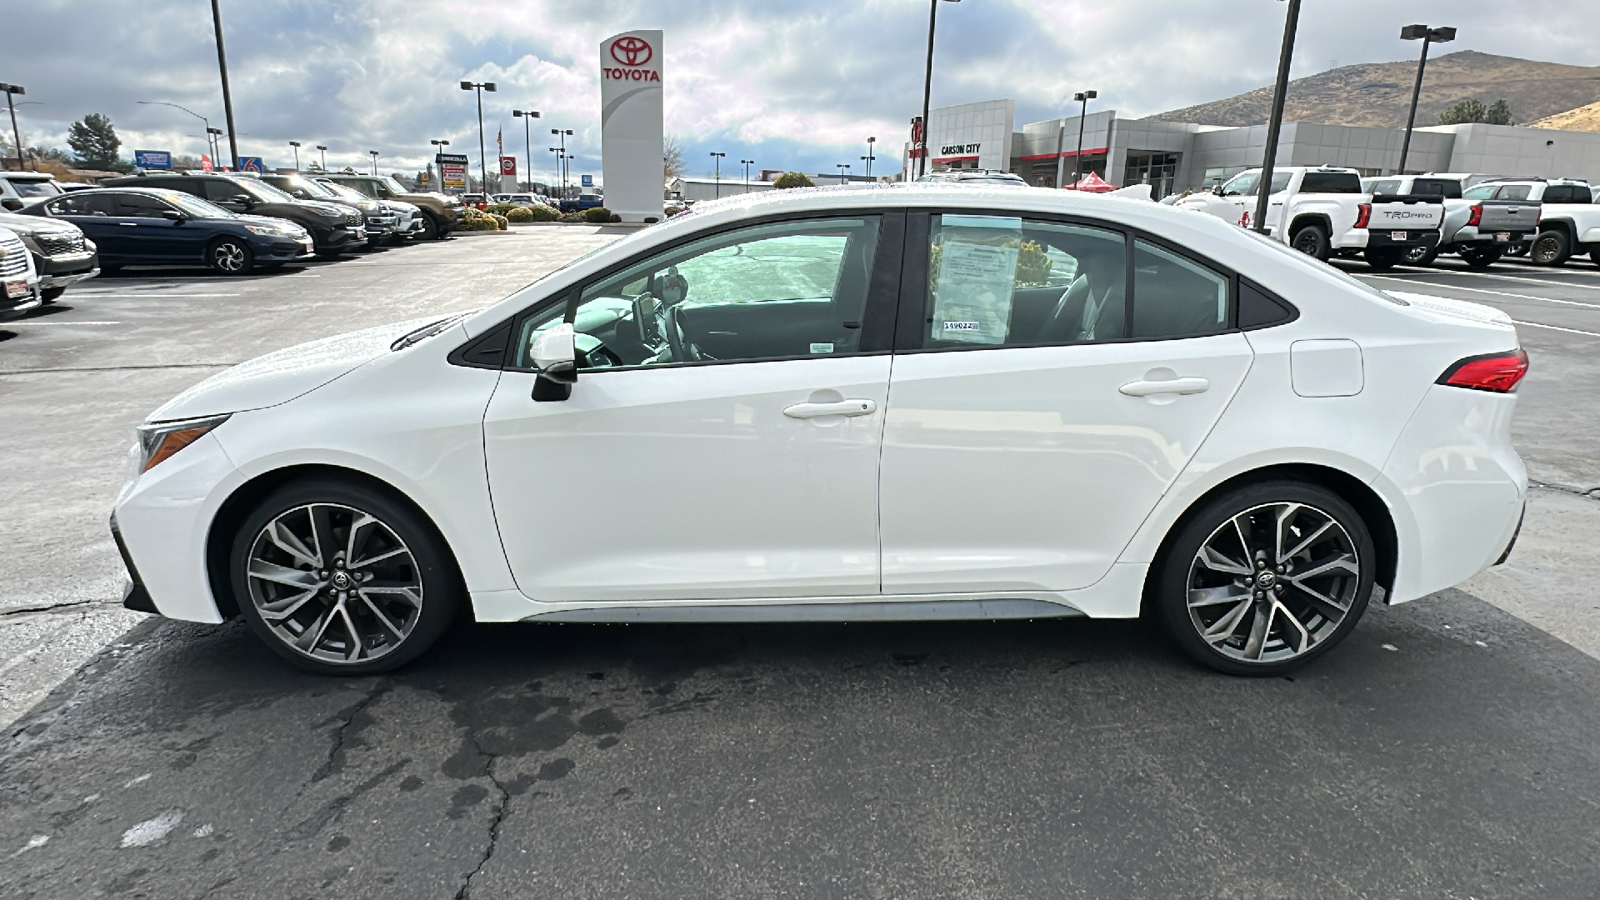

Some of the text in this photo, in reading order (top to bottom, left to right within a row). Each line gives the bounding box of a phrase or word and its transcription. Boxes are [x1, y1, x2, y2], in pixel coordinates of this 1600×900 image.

[603, 68, 660, 82] TOYOTA
[942, 144, 980, 155] CARSON CITY
[244, 158, 259, 172] 6
